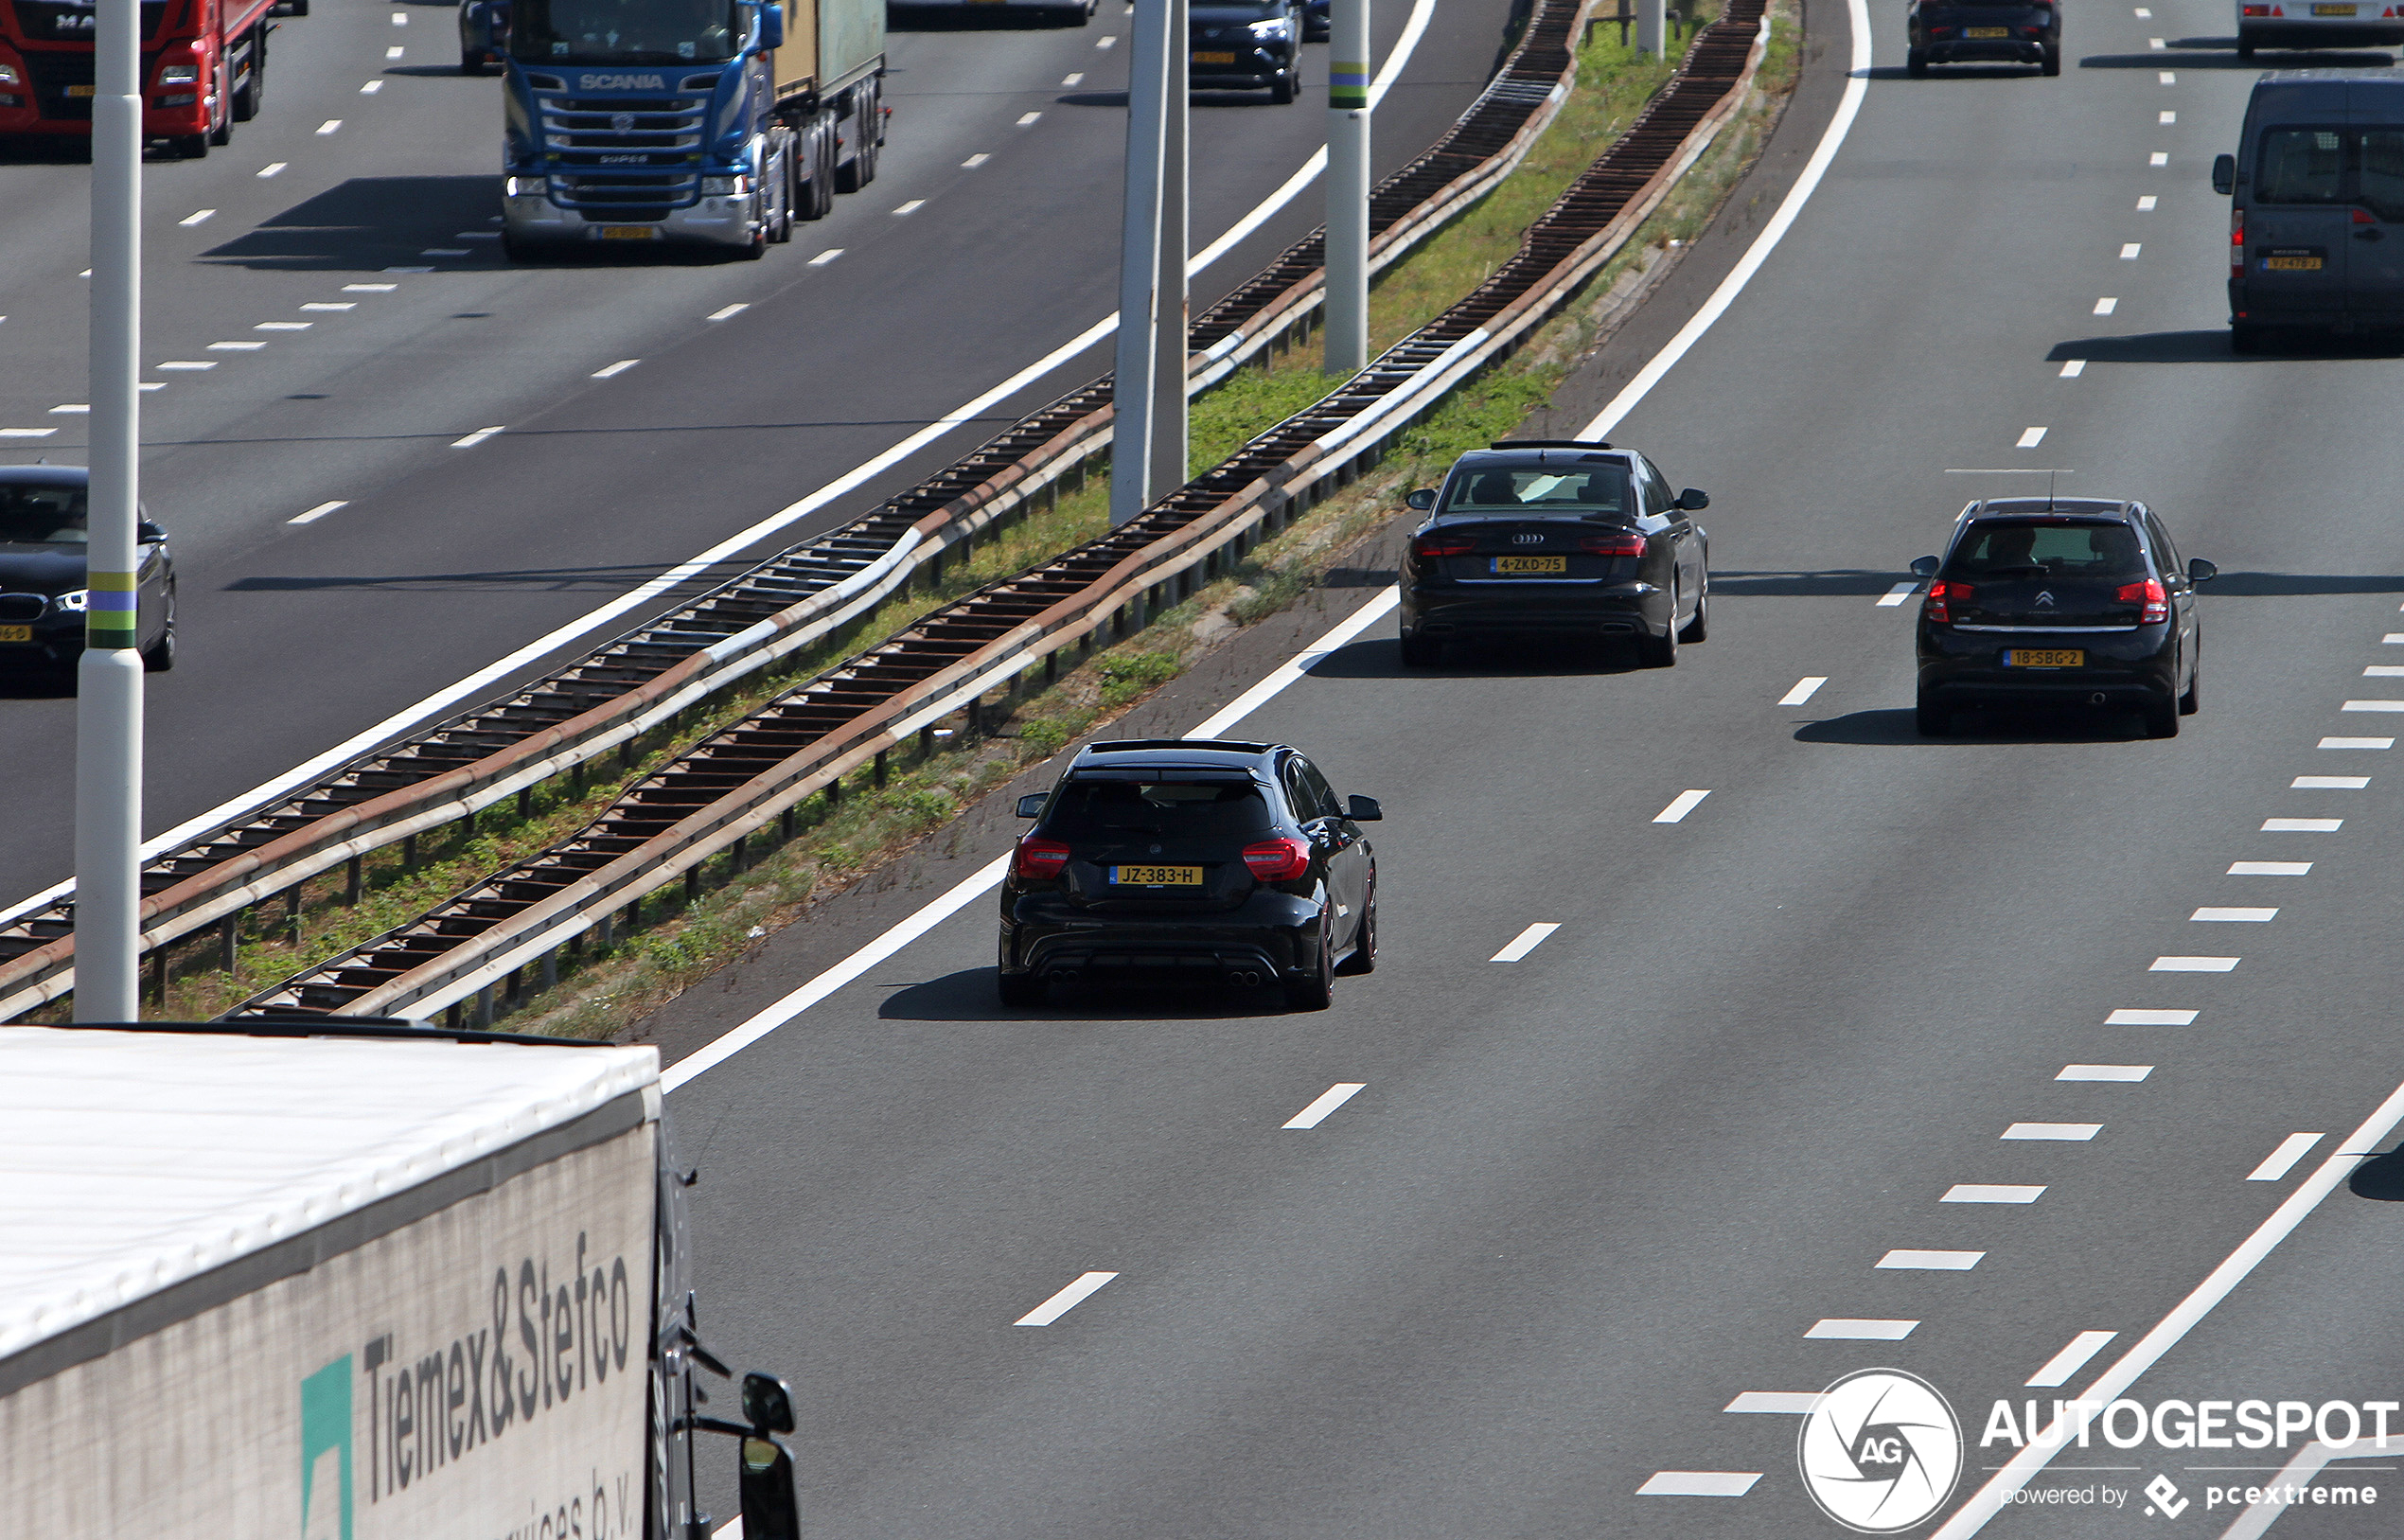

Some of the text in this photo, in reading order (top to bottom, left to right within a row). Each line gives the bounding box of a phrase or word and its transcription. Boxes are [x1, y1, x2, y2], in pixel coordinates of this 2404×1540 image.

[579, 74, 665, 90] SCANIA
[1501, 558, 1561, 571] 4-ZKD-75
[2015, 651, 2077, 664] 18-SBG-2
[1122, 868, 1193, 883] JZ-383-H
[363, 1231, 628, 1503] Tiemex&Stefco
